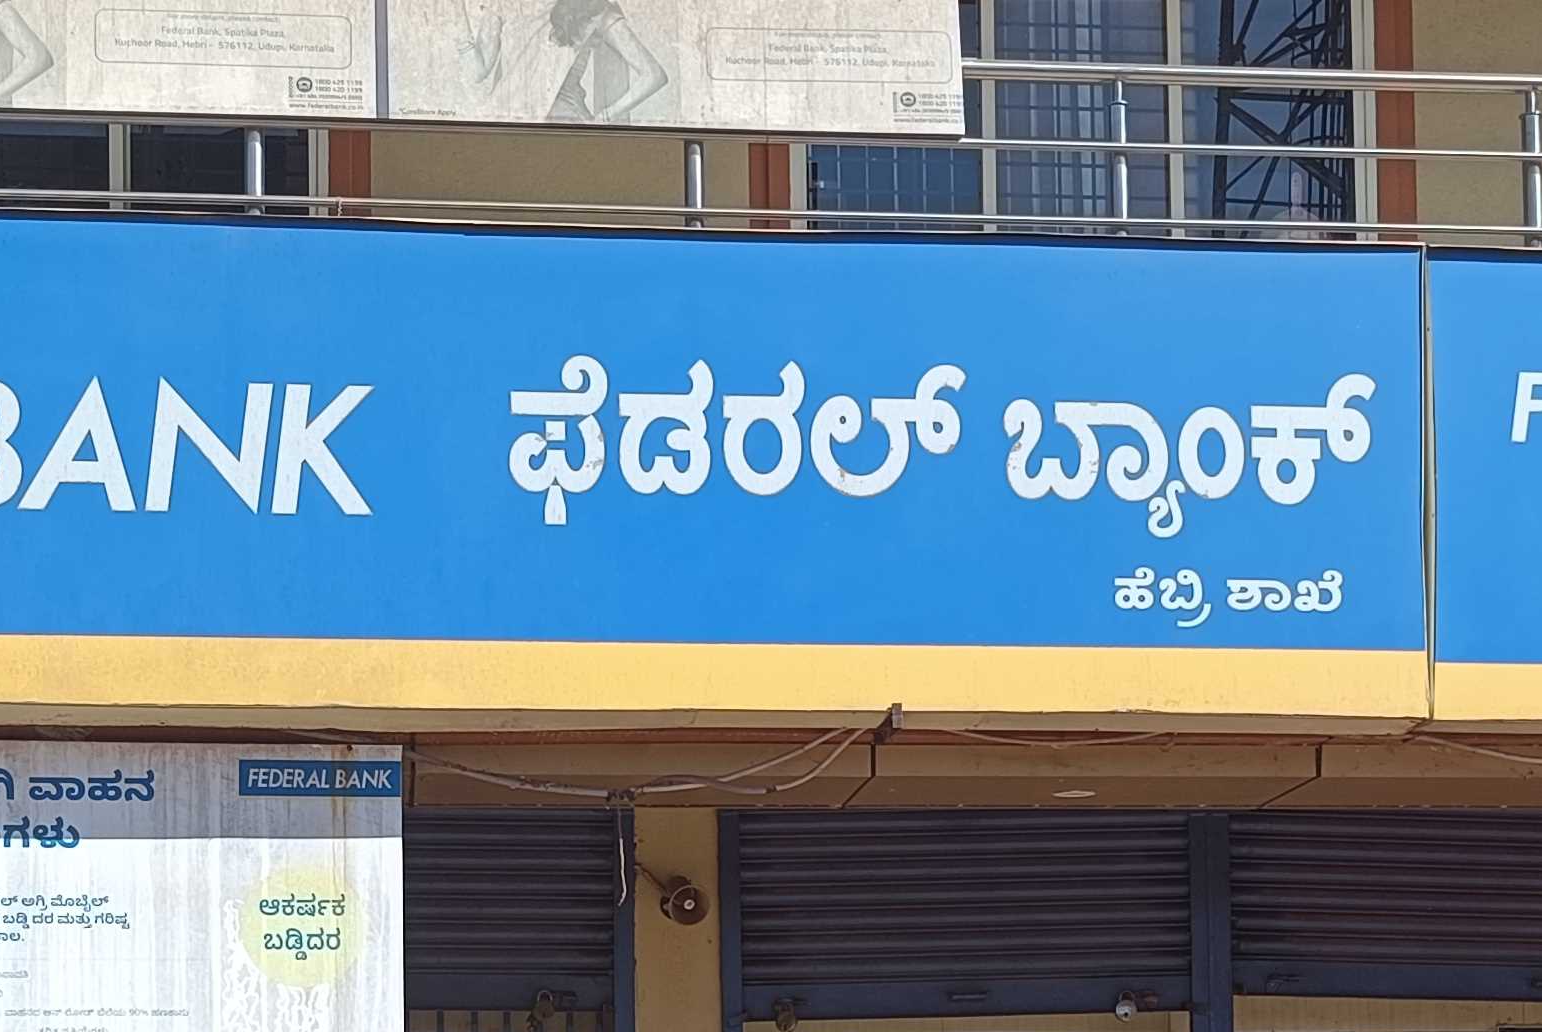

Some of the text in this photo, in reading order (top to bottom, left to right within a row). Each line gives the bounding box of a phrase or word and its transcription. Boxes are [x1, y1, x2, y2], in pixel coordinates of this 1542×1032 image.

[507, 352, 1375, 539] ಫೆಡರಲ್ ಬ್ಯಾಂಕ್
[1113, 569, 1344, 630] ಹೆಬ್ರಿ ಶಾಖೆ
[28, 769, 156, 802] ವಾಹನ
[247, 768, 392, 789] FEDERAL BANK
[32, 914, 53, 925] ದರ
[259, 893, 346, 917] ಆಕರ್ಷಕ
[263, 927, 341, 961] ಬಡ್ಡಿದರ
